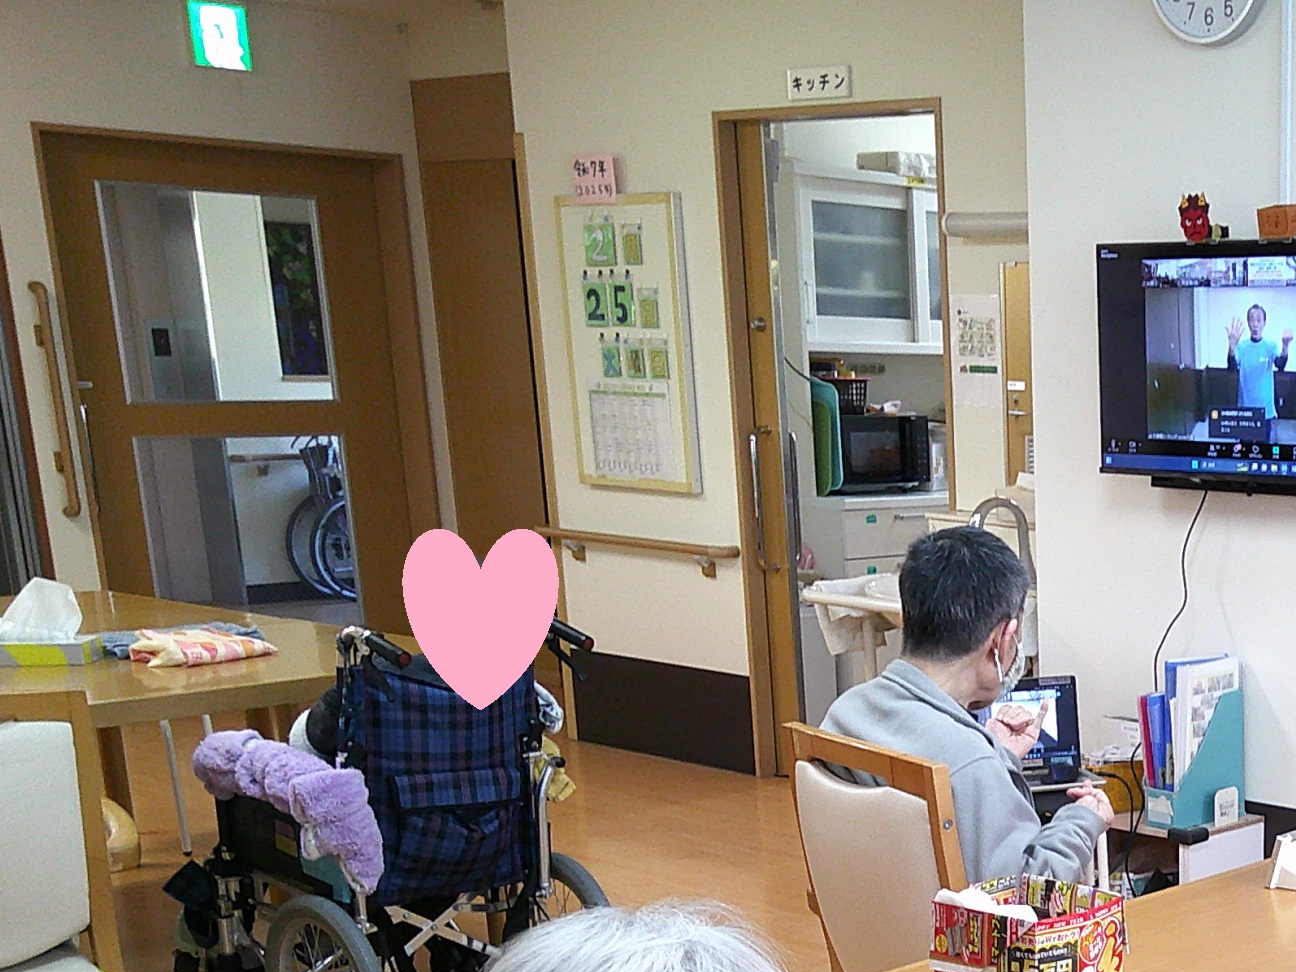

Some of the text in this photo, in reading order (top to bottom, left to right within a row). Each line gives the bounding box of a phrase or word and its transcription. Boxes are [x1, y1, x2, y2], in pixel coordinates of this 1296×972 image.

[1187, 2, 1195, 20] 7
[1204, 7, 1214, 26] 6
[793, 73, 845, 92] キッチン
